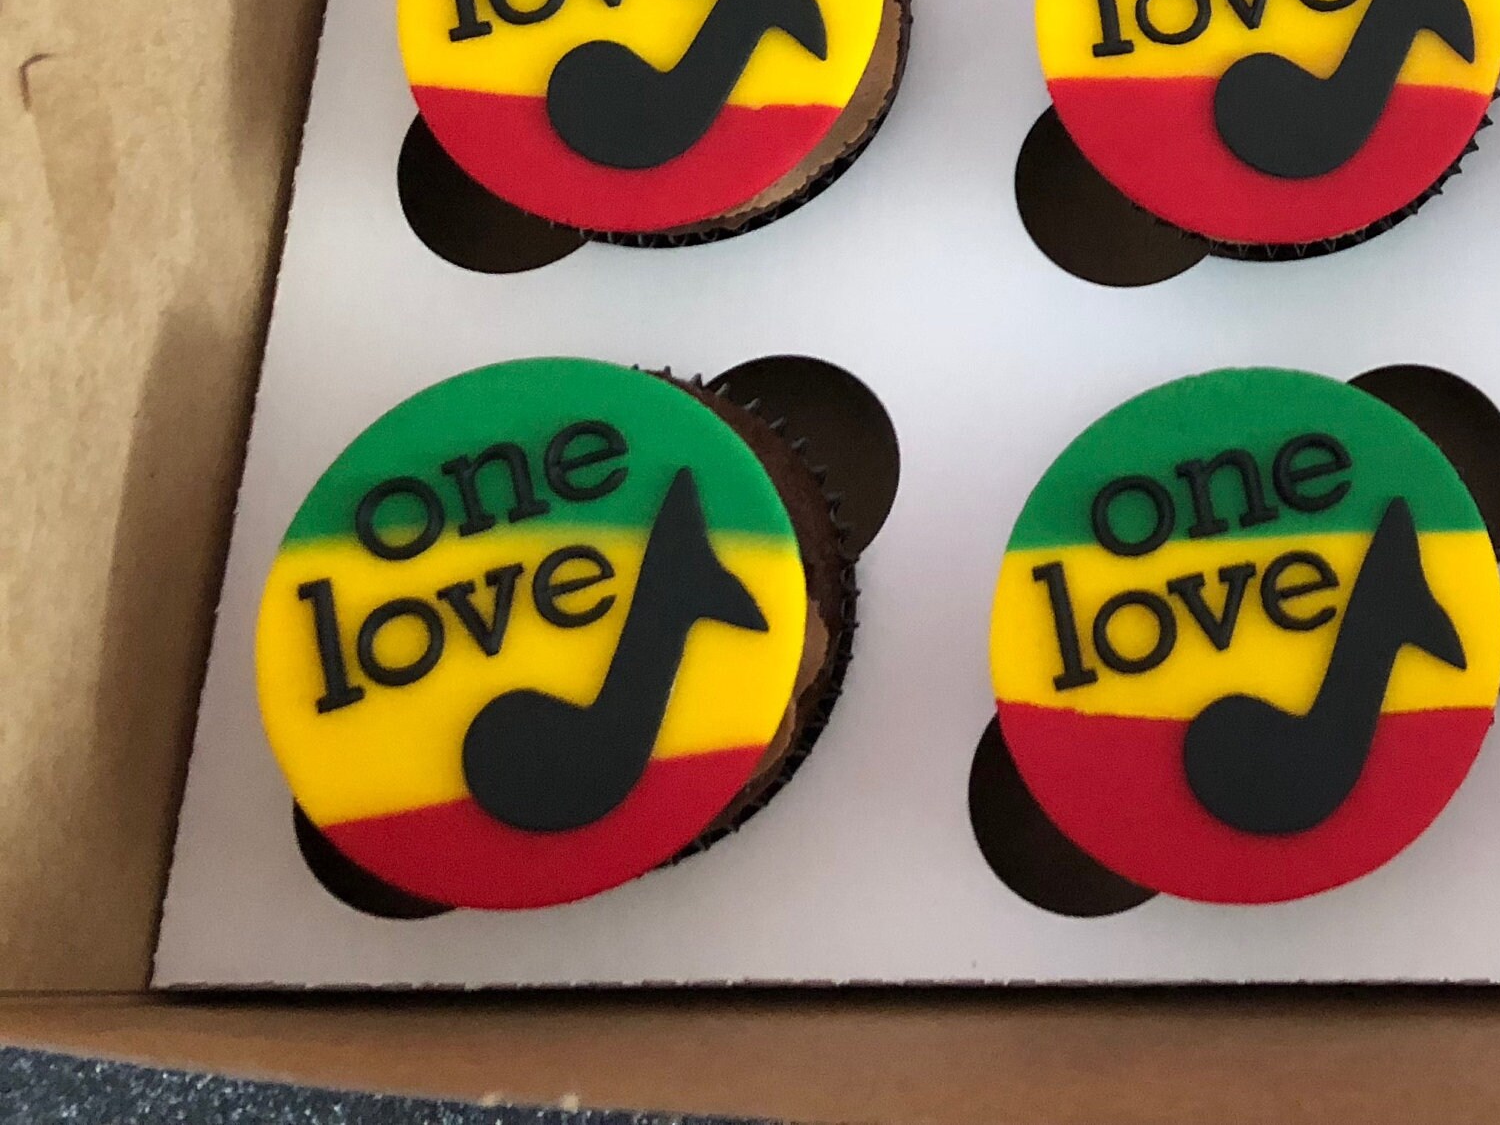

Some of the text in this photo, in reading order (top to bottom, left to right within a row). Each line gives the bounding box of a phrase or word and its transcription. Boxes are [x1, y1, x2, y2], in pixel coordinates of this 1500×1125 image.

[354, 421, 627, 560] one
[1088, 433, 1352, 557] one
[299, 547, 613, 713] love
[1034, 553, 1338, 690] love
